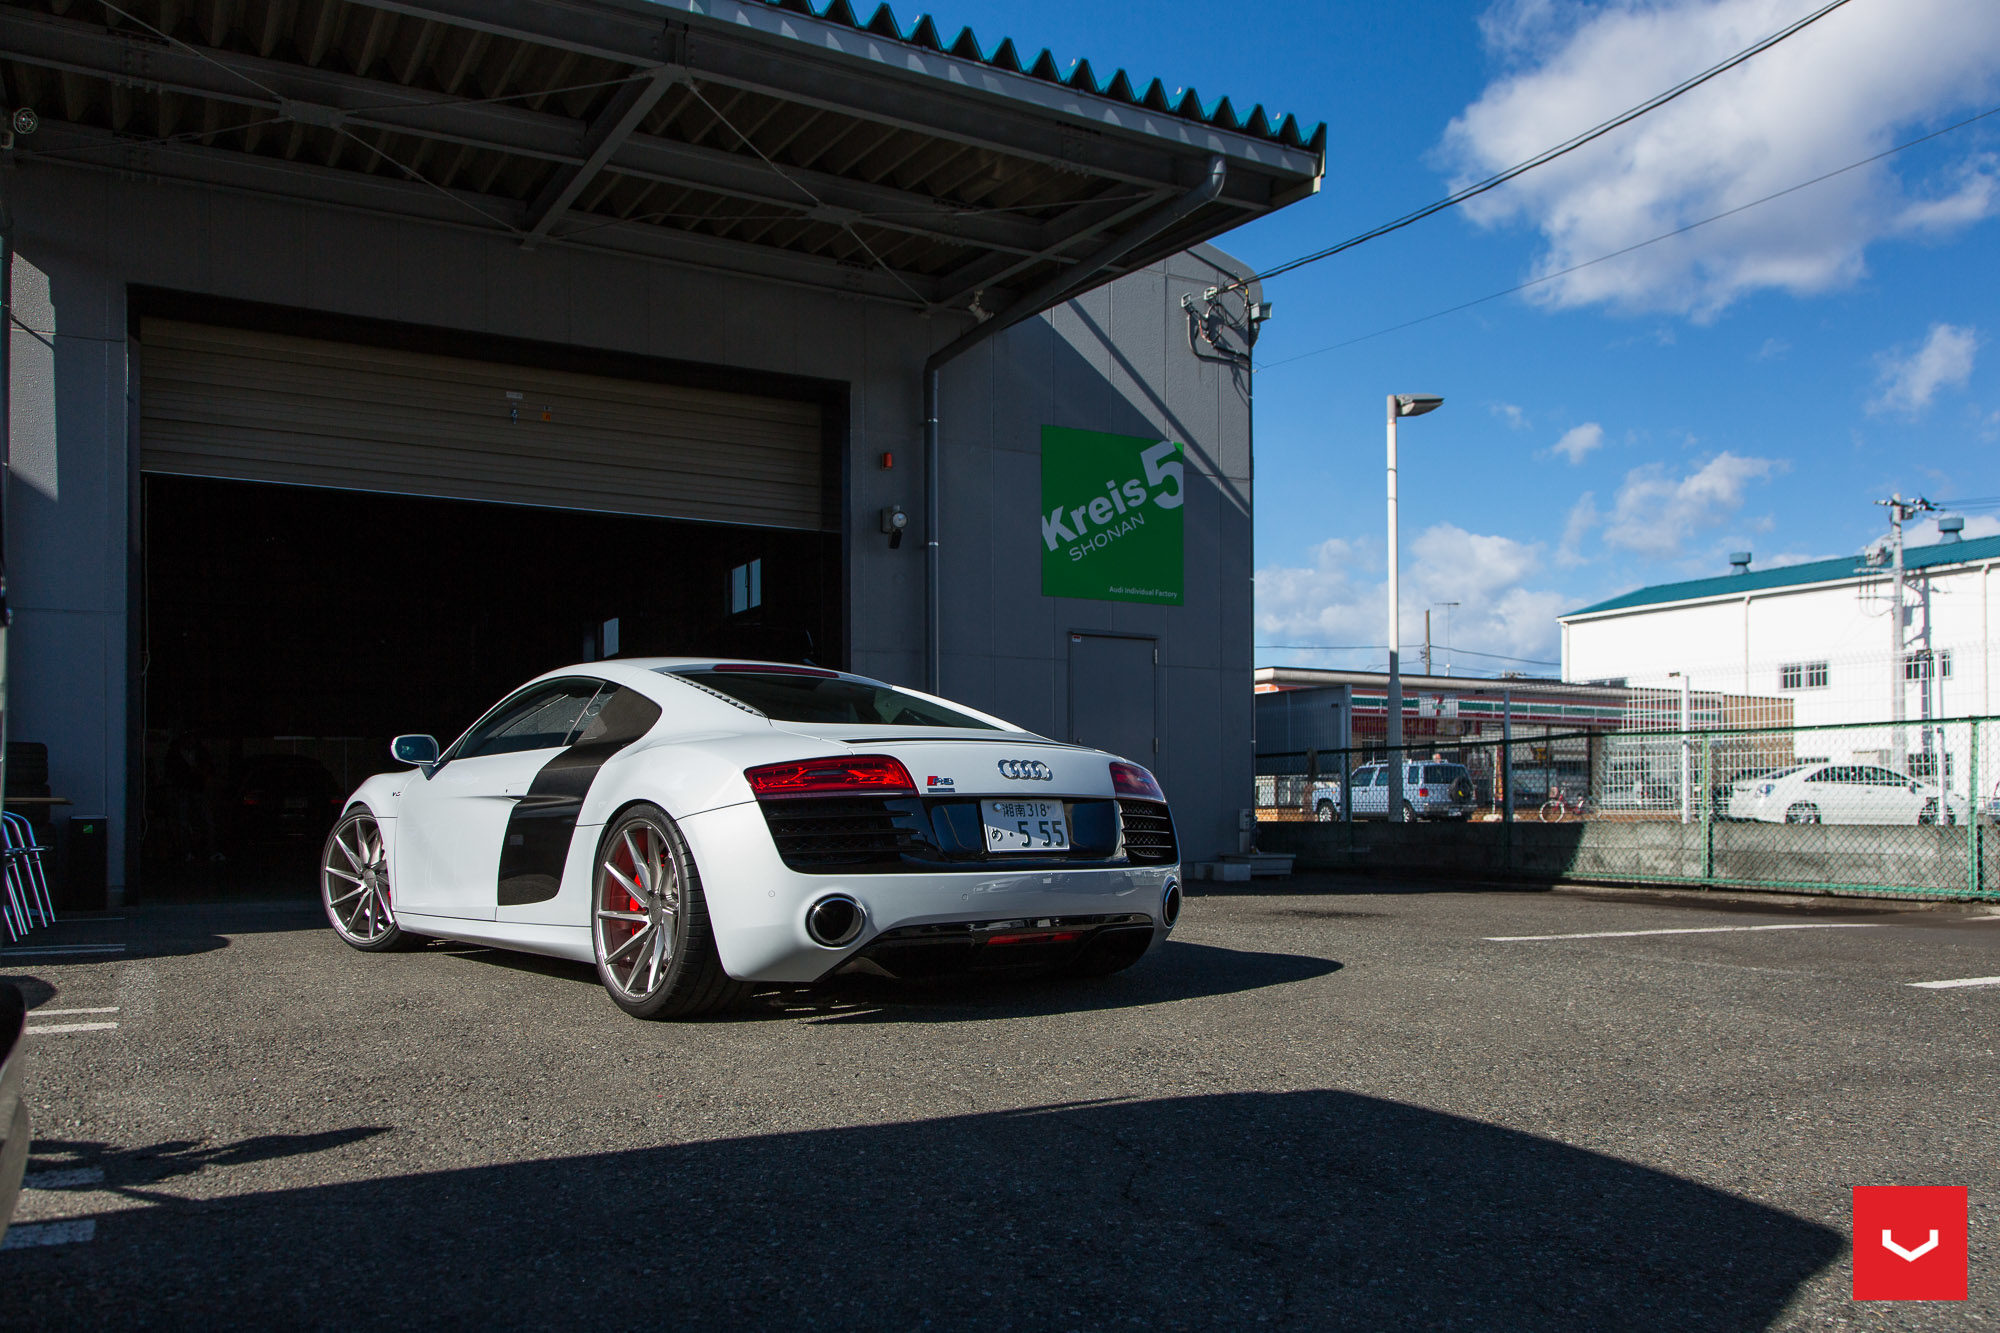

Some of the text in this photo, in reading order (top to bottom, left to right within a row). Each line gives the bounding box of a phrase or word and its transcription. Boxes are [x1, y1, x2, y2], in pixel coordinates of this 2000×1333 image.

[1042, 440, 1183, 552] Kreis 5
[1069, 512, 1145, 562] SHONAN
[1124, 587, 1154, 596] Individual
[1155, 589, 1177, 598] Factory
[991, 828, 1003, 842] め
